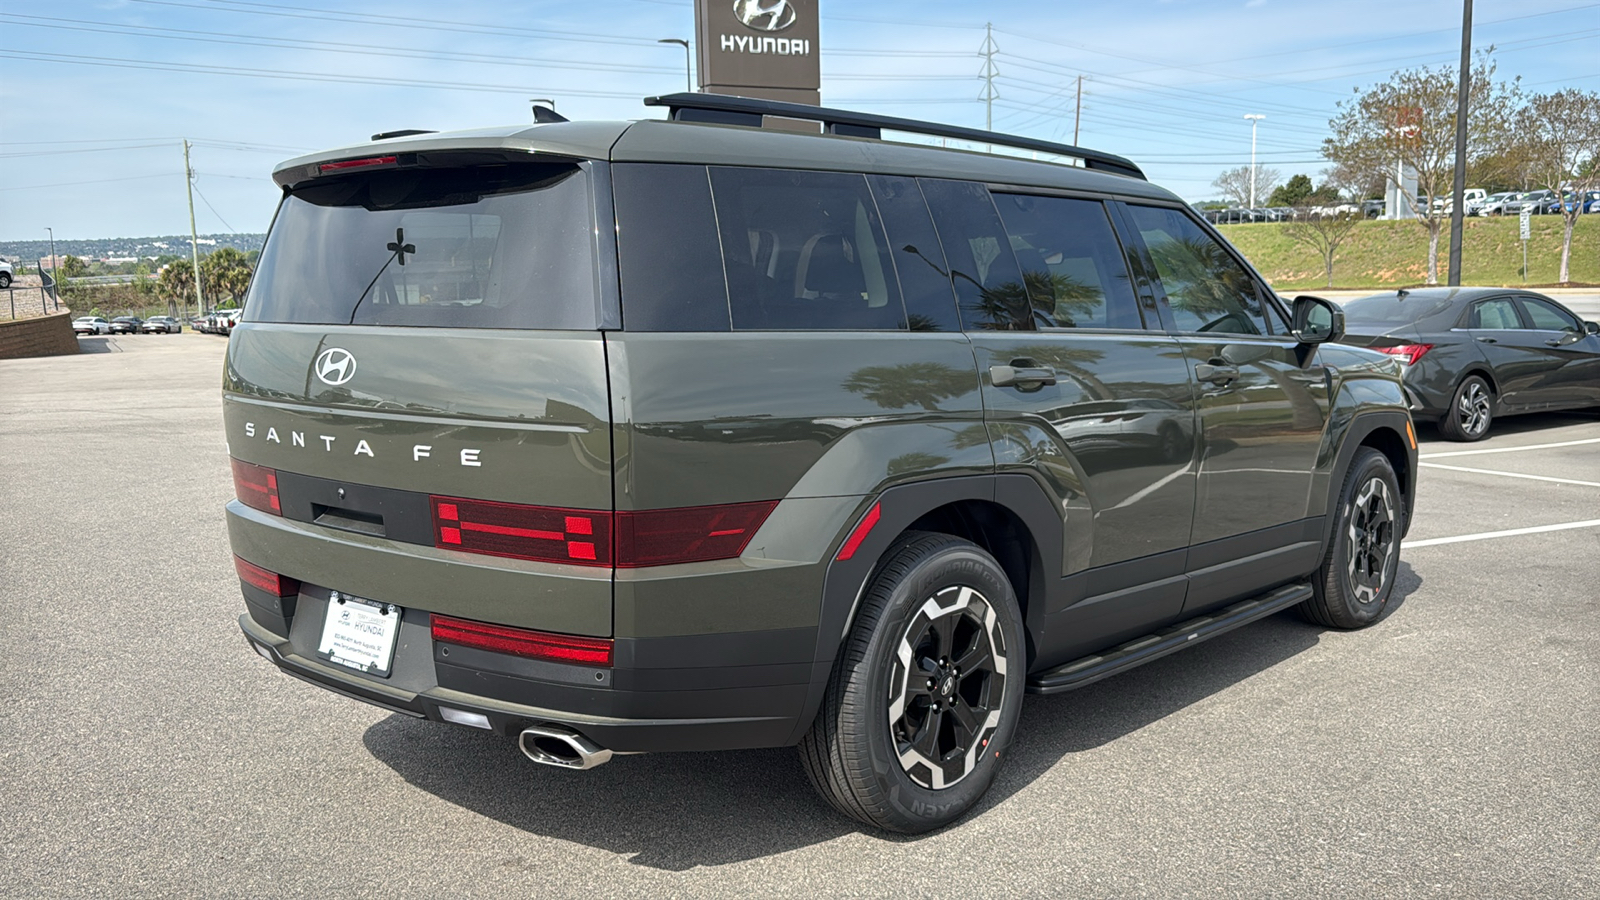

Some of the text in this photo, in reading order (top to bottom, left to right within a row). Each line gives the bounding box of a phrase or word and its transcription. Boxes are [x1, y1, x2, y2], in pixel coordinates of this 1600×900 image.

[720, 34, 809, 56] HYUNDAI
[245, 422, 482, 467] SANTA FE
[354, 621, 385, 637] HYUNDAI
